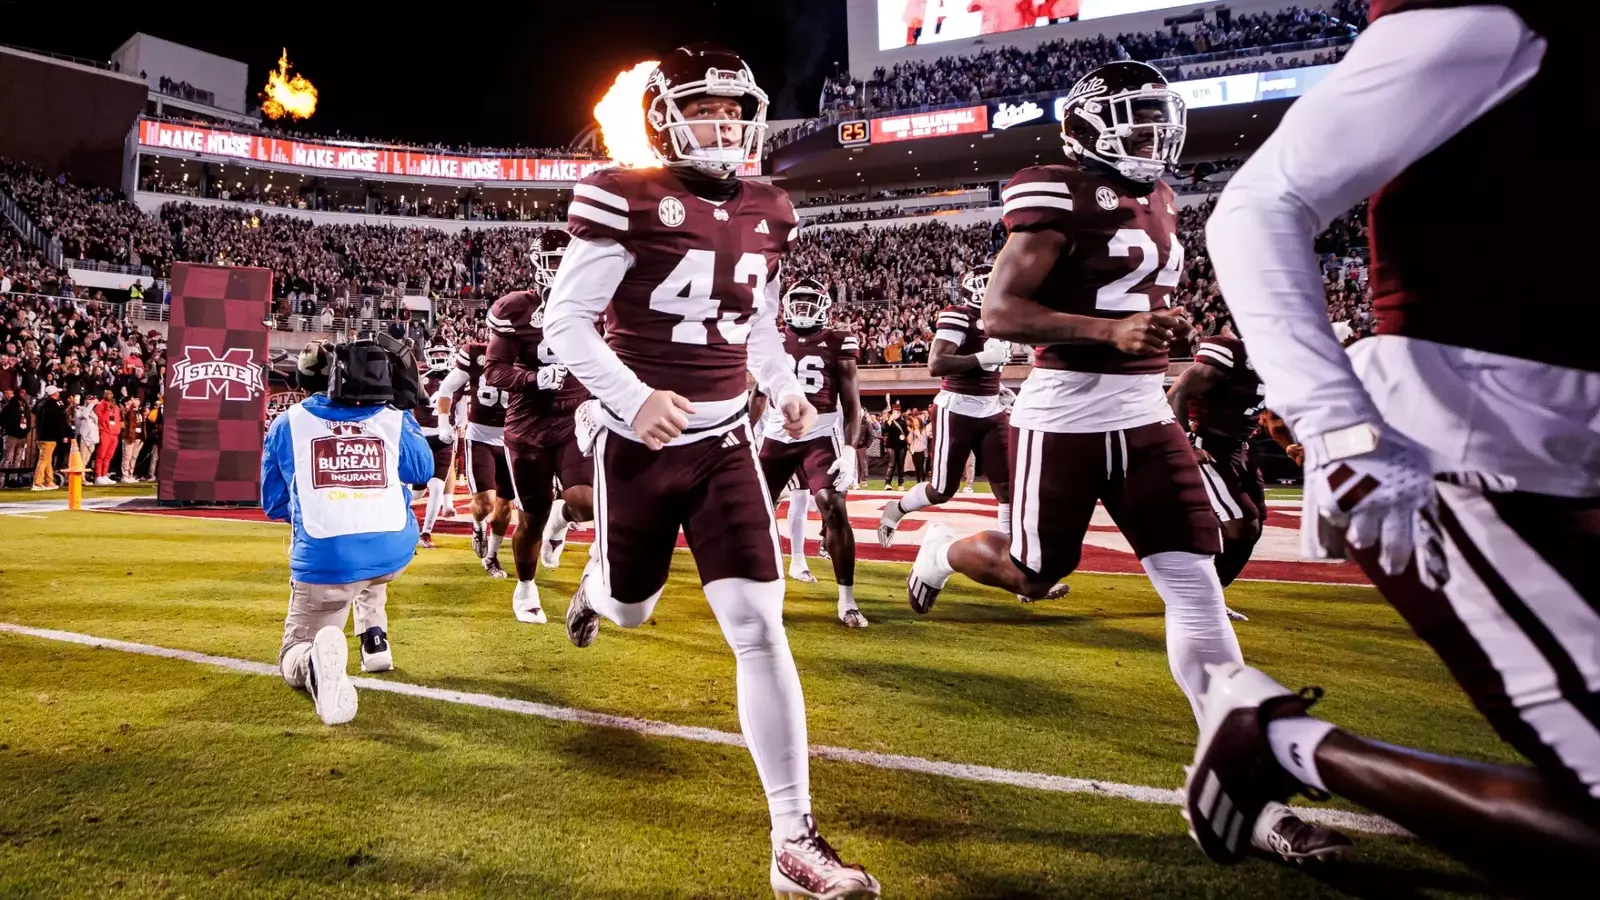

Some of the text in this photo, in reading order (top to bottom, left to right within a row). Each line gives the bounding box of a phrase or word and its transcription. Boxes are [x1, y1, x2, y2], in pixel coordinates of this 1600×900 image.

[843, 124, 865, 140] 25
[160, 129, 252, 157] MAKE NOISE
[299, 147, 378, 172] MAKE NOISE
[421, 160, 499, 180] MAKE NOISE
[540, 163, 577, 180] MAKE
[660, 198, 684, 226] SEC
[1095, 229, 1184, 311] 24
[649, 249, 768, 345] 43
[189, 364, 246, 380] STATE
[787, 354, 825, 393] 6
[270, 393, 306, 404] STAT
[336, 442, 379, 456] FARM
[318, 456, 380, 470] BUREAU
[331, 472, 382, 482] INSURANCE
